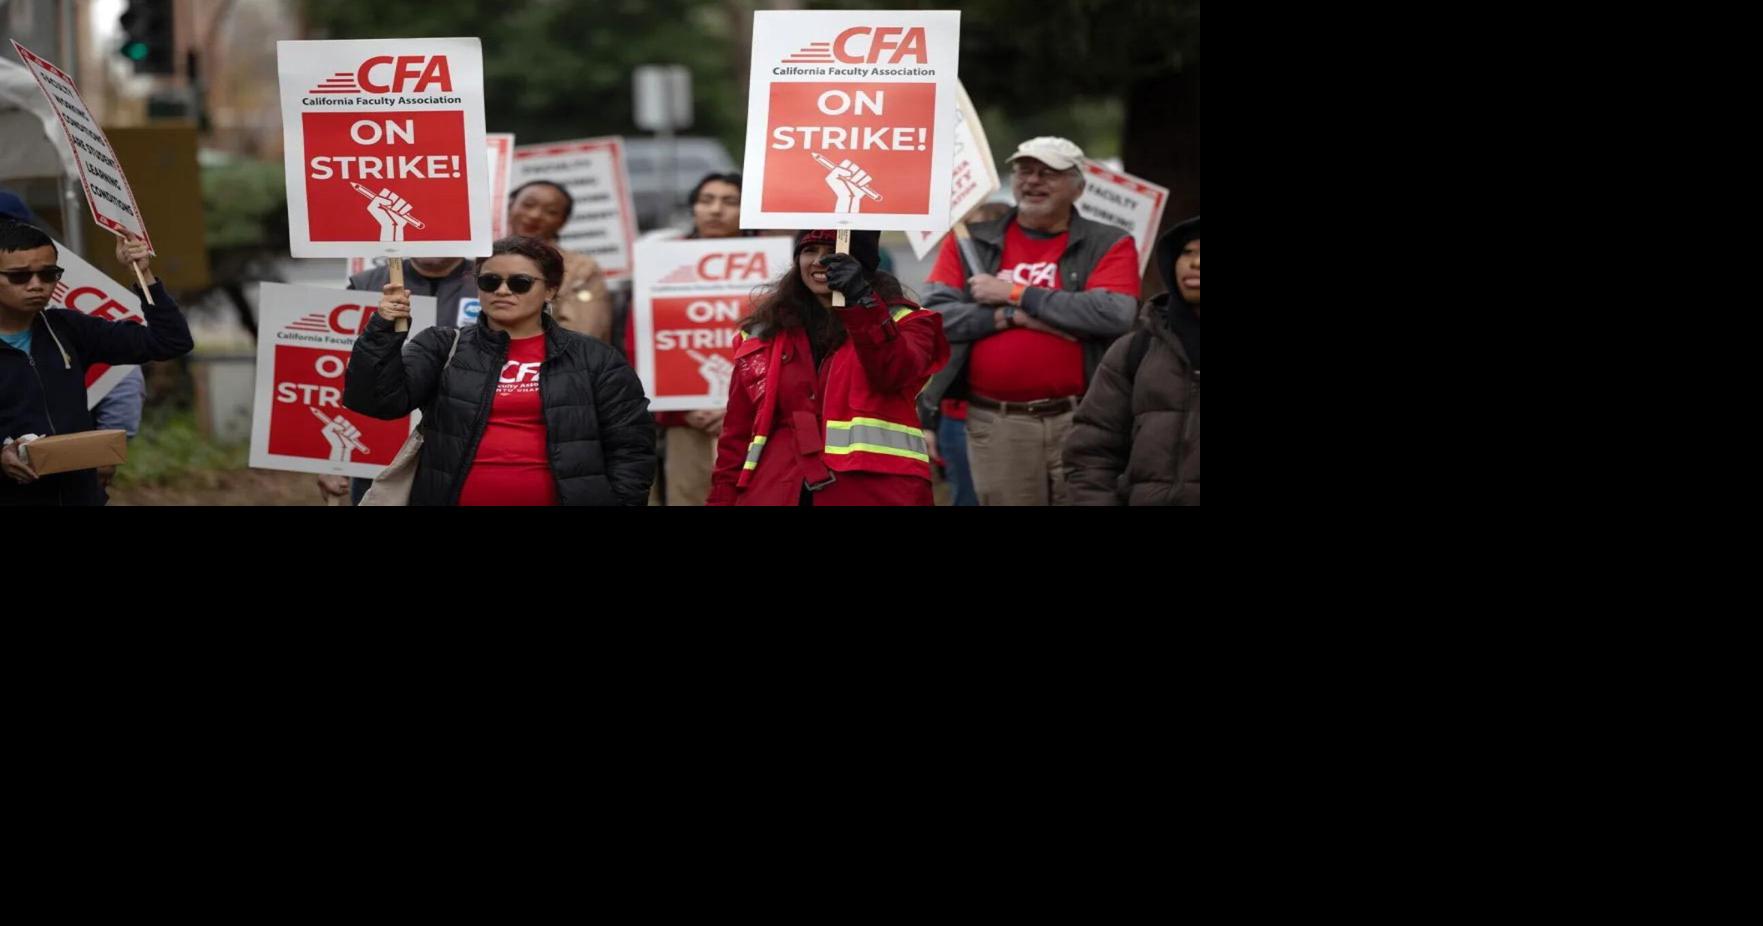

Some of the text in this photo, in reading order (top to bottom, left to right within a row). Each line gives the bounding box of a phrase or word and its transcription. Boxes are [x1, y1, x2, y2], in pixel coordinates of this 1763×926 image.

[833, 26, 928, 64] CFA
[357, 55, 453, 94] CFA
[772, 67, 936, 77] California Faculty Association
[302, 95, 461, 106] California Faculty Association
[817, 89, 884, 116] ON
[350, 119, 415, 145] ON
[772, 126, 927, 151] STRIKE!
[310, 155, 461, 180] STRIKE!
[697, 252, 768, 281] CFA
[1012, 262, 1058, 288] CFA
[64, 286, 145, 325] CF
[687, 299, 740, 323] ON
[277, 331, 354, 345] California Facult
